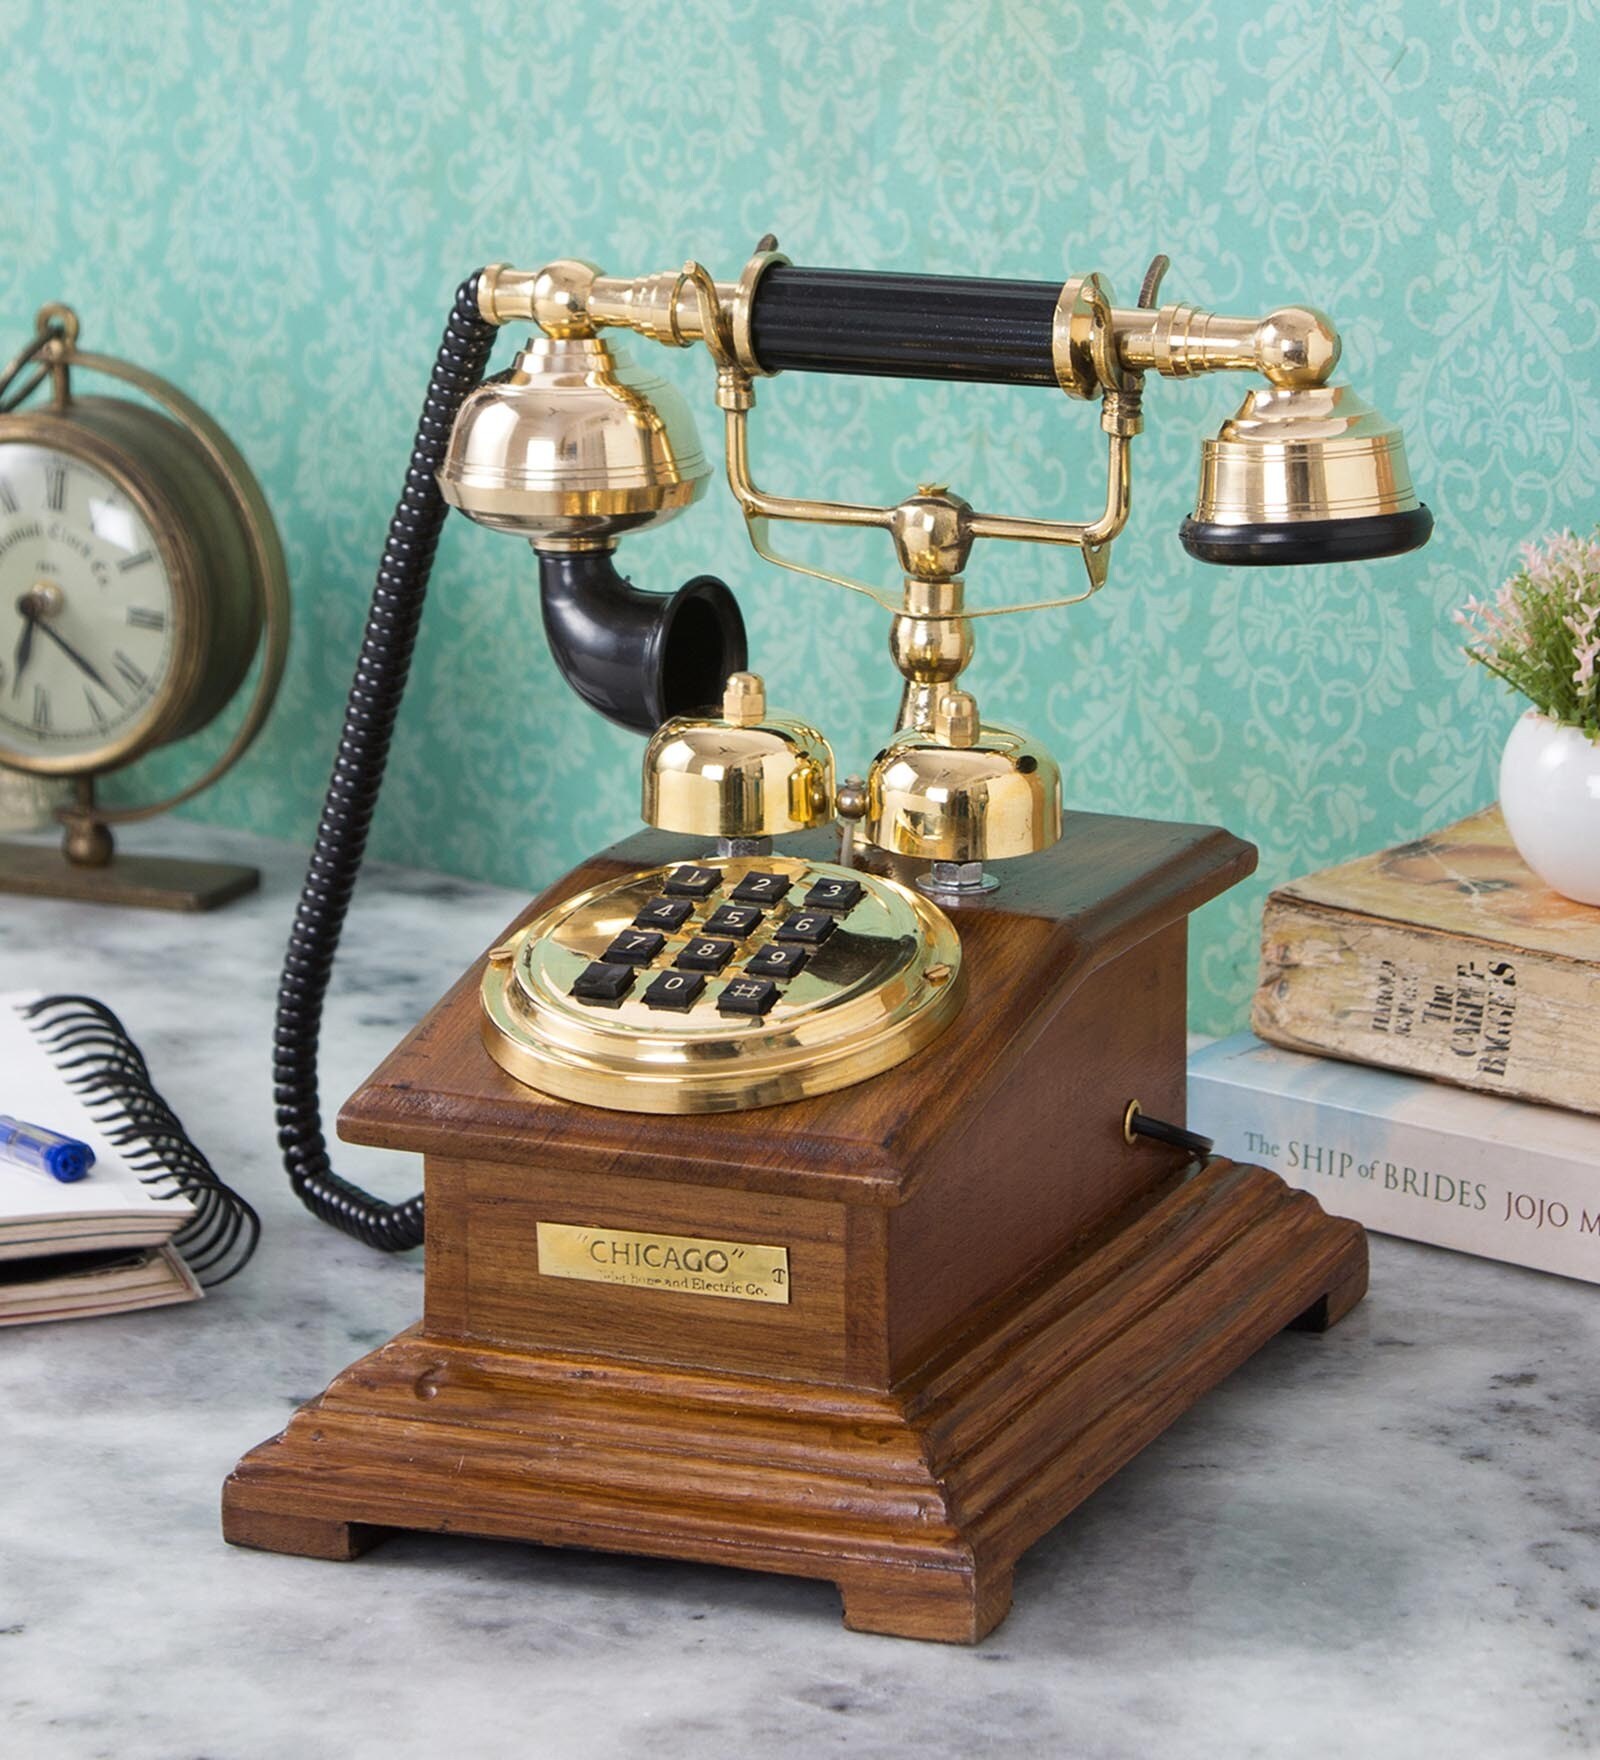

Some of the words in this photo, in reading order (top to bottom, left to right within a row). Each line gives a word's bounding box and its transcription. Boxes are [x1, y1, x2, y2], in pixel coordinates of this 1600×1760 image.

[751, 878, 772, 892] 2
[822, 885, 841, 898] 3
[653, 904, 671, 918] 4
[724, 911, 745, 925] 5
[795, 918, 813, 932] 6
[625, 935, 646, 949] 7
[697, 943, 716, 957] 8
[769, 951, 787, 965] 9
[664, 976, 683, 991] 0
[1421, 985, 1454, 1025] The
[1244, 1131, 1280, 1158] The
[1287, 1141, 1353, 1179] SHIP
[1358, 1159, 1380, 1181] of
[1384, 1162, 1488, 1212] BRIDES
[1504, 1191, 1569, 1230] JOJO
[664, 1276, 689, 1290] and
[691, 1277, 743, 1295] Electric
[745, 1283, 769, 1298] Co.
